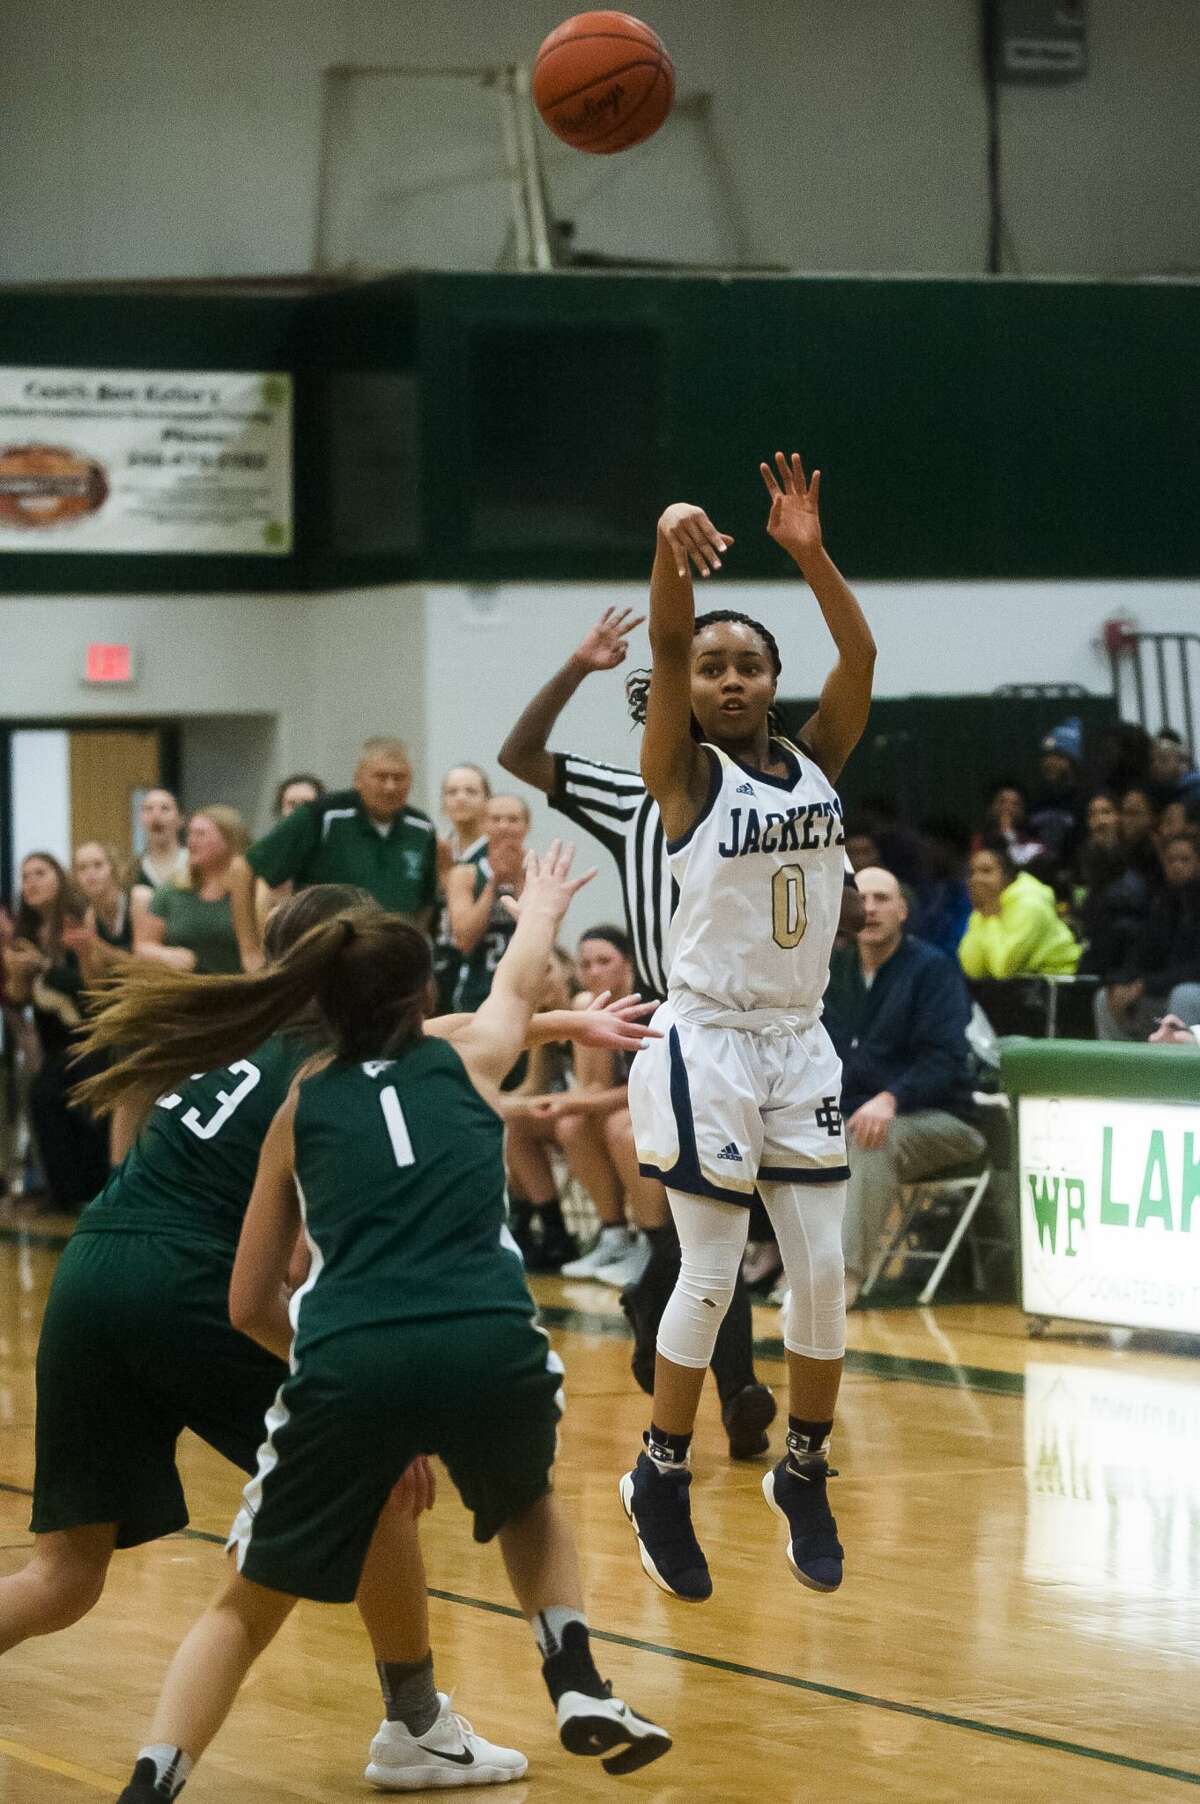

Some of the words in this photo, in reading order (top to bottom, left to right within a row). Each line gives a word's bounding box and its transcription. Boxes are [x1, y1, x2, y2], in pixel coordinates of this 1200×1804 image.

[771, 863, 808, 949] 0
[155, 1059, 261, 1139] 3
[379, 1085, 416, 1168] 1
